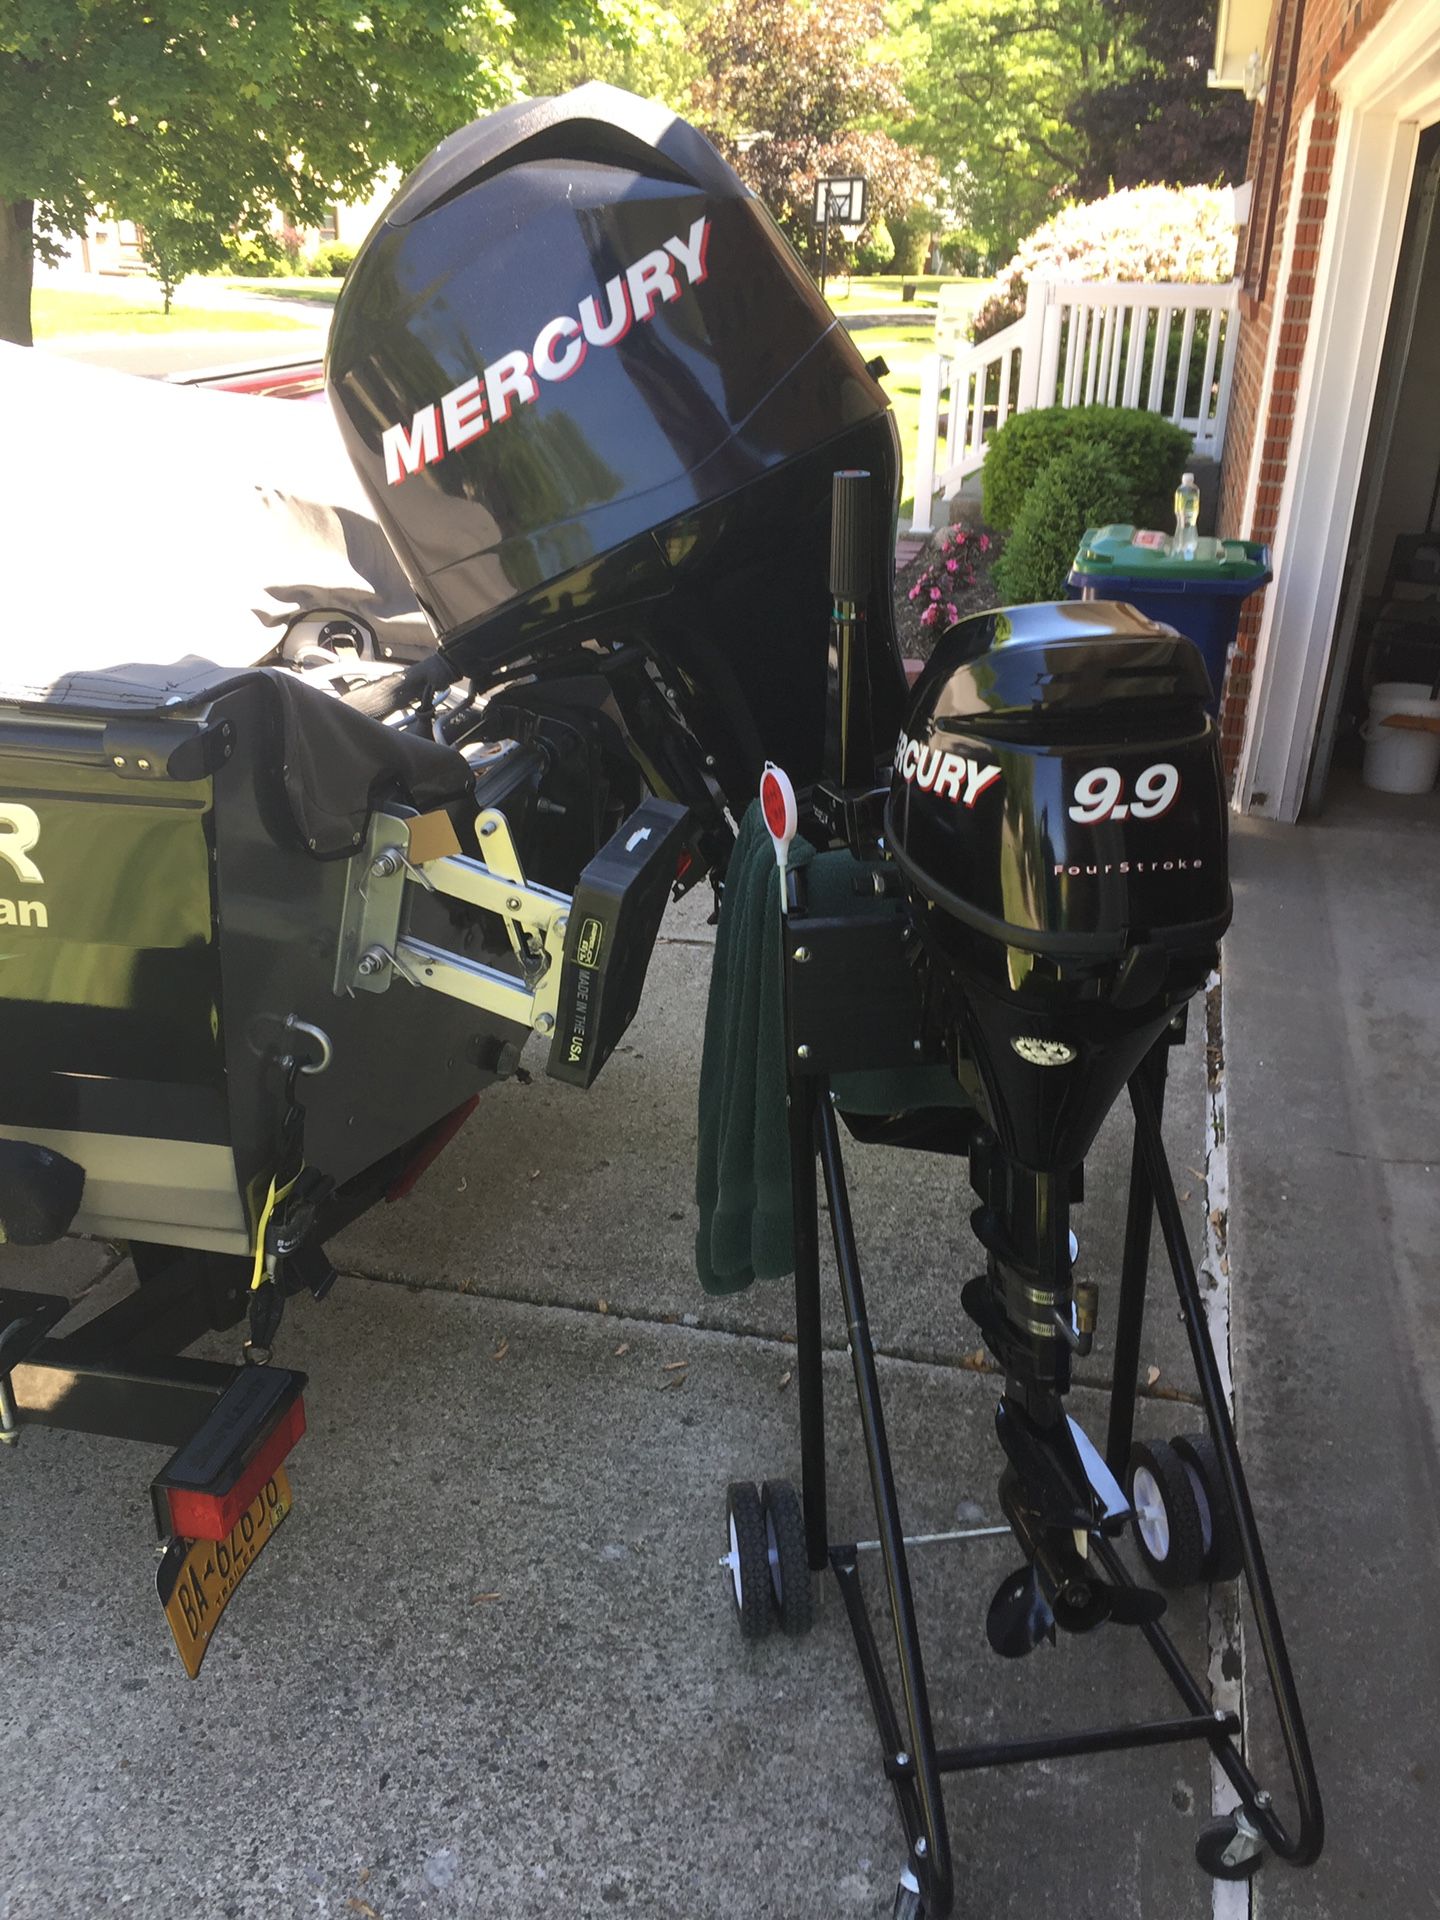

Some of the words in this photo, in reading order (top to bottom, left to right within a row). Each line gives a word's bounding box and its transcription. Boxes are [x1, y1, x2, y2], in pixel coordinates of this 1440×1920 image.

[382, 216, 711, 487] MERCURY
[1068, 763, 1182, 826] 9.9
[1054, 858, 1203, 876] FourStroke
[577, 969, 591, 1001] MADE
[576, 1000, 588, 1014] IN
[573, 1014, 587, 1036] THE
[568, 1036, 584, 1062] USA
